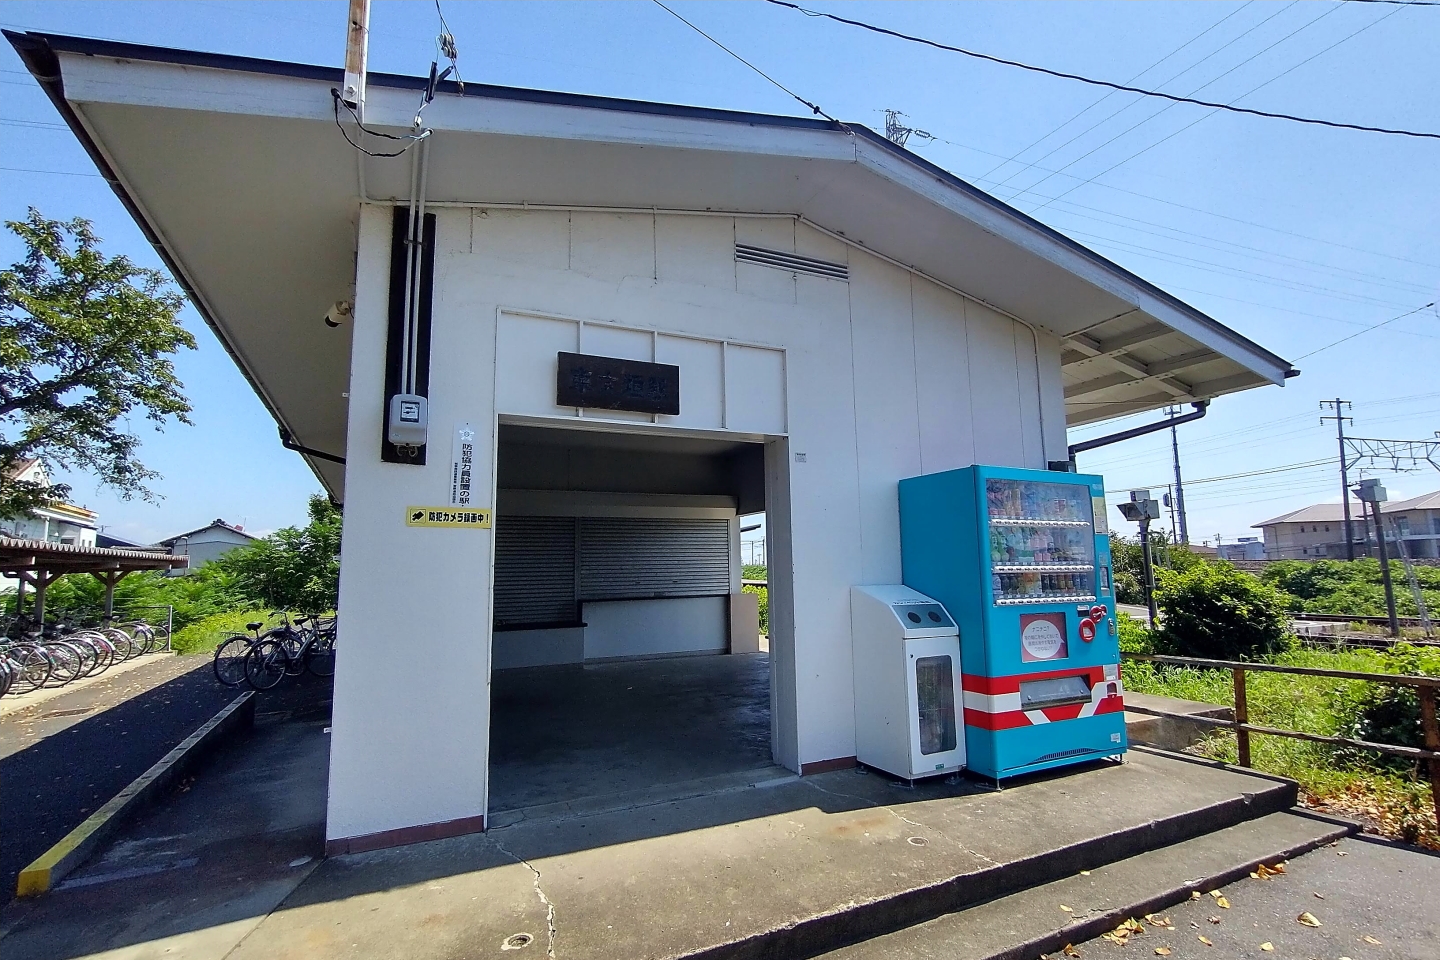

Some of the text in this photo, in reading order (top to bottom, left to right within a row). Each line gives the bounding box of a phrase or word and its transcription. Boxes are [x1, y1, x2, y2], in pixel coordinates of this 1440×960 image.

[458, 443, 474, 505] 防犯協力員設置の駅
[428, 511, 490, 524] 防犯カメラ録画中!
